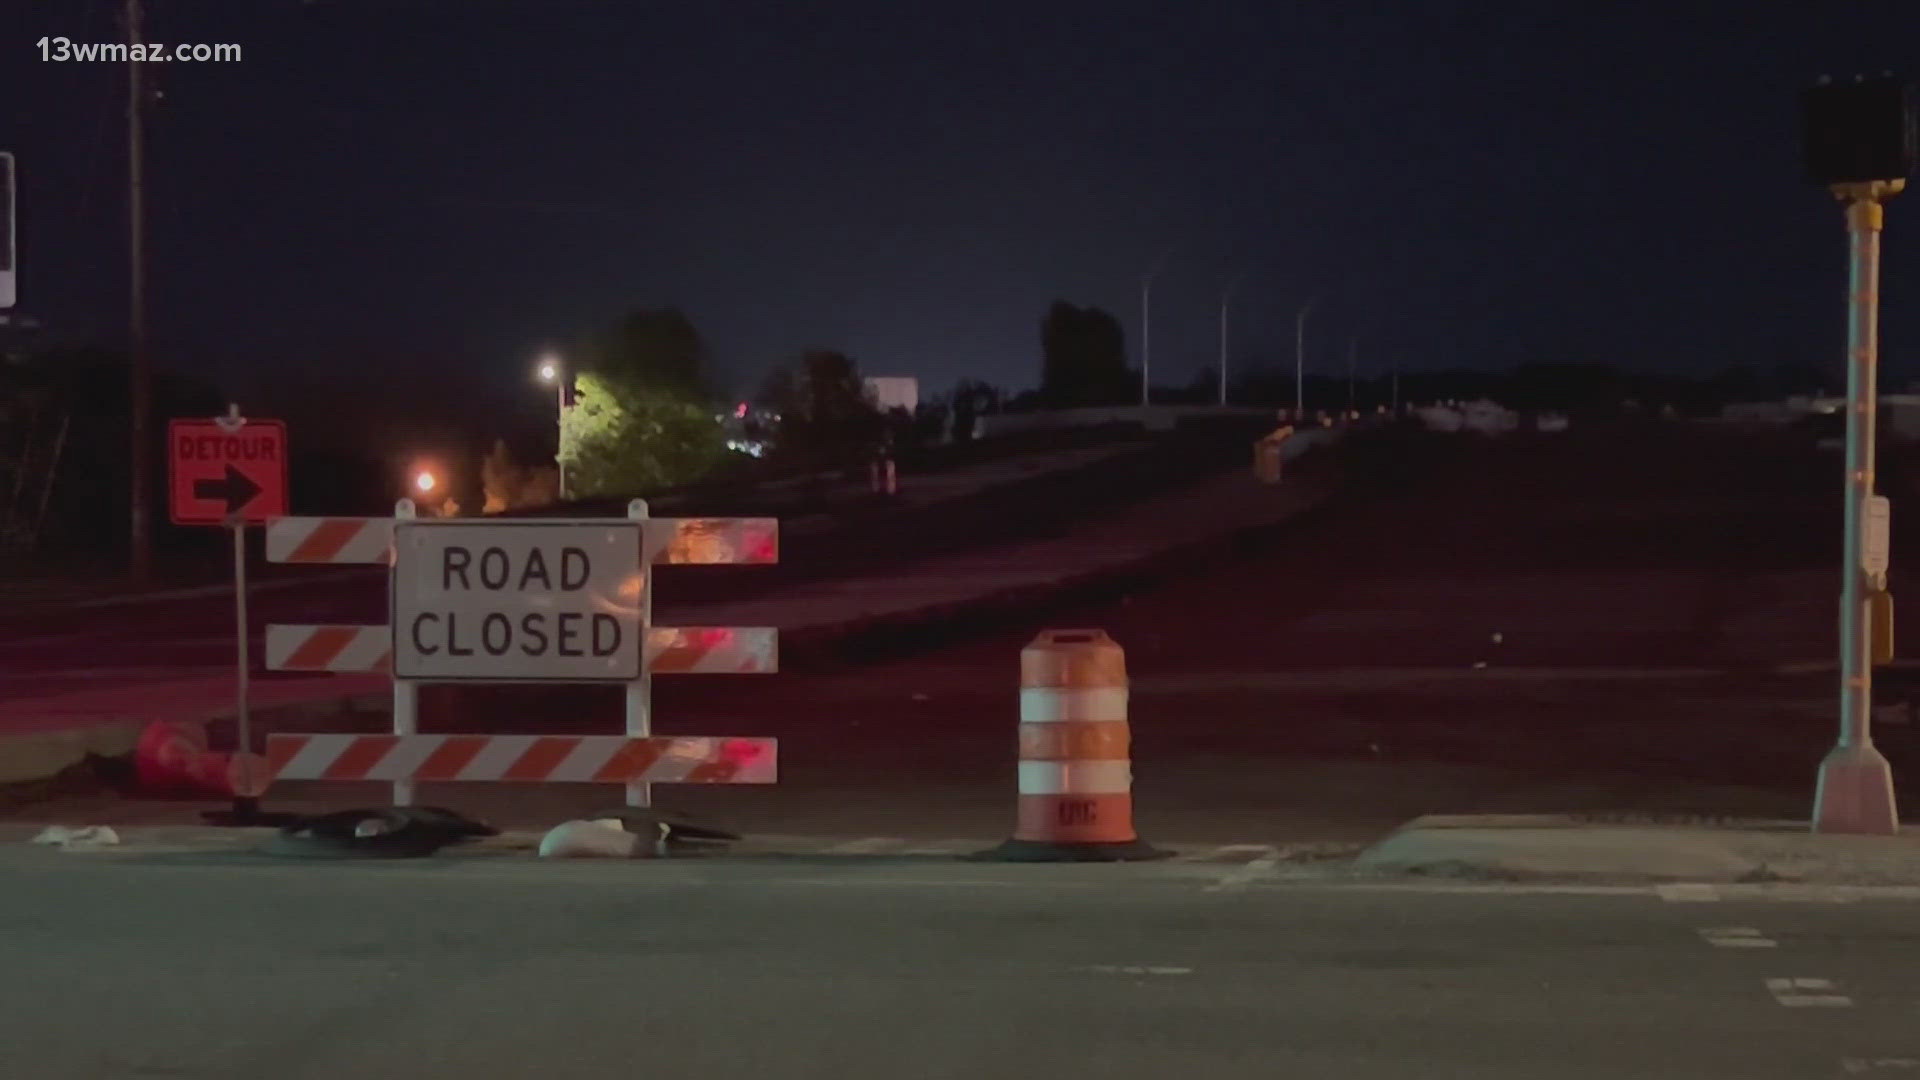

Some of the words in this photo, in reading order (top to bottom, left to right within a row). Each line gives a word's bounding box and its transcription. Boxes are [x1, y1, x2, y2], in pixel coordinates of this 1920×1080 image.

[179, 436, 276, 461] DETOUR
[443, 546, 591, 591] ROAD
[412, 612, 622, 657] CLOSED
